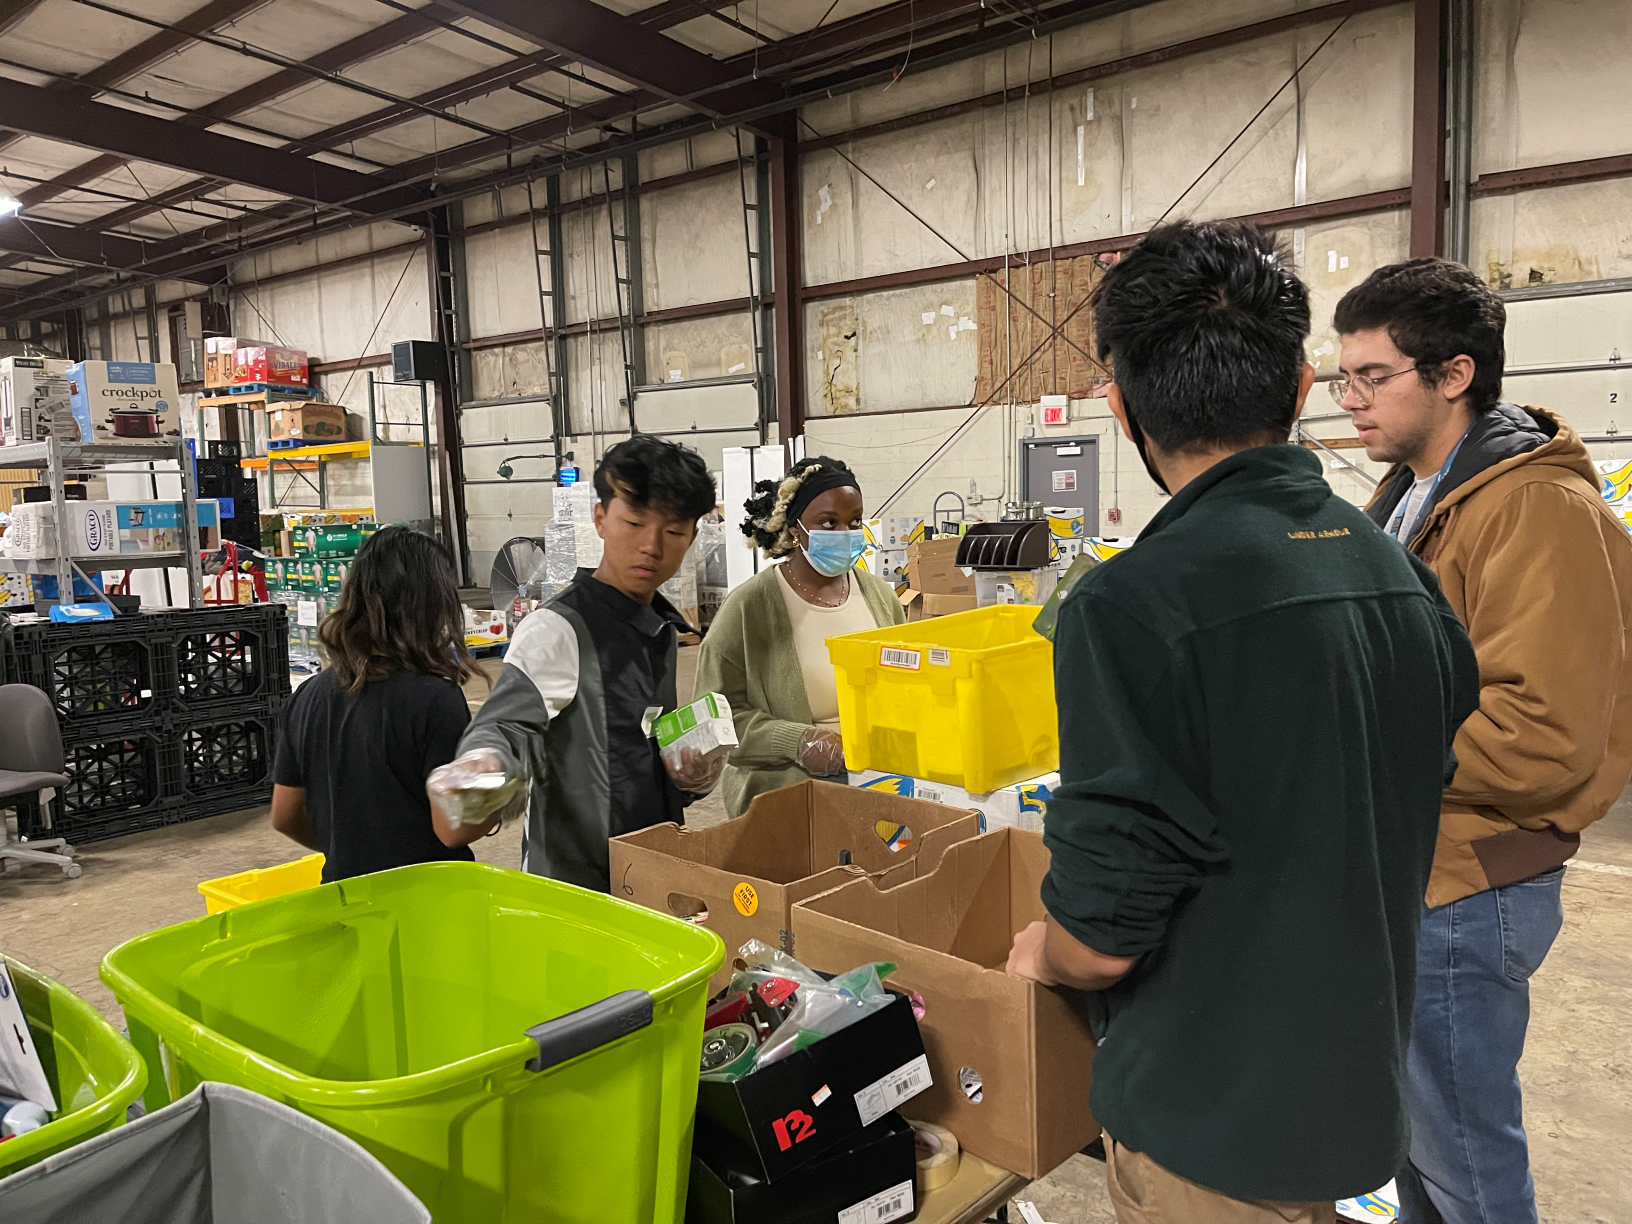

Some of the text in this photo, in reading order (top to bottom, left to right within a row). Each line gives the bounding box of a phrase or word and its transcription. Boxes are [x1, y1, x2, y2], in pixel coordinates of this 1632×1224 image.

[102, 386, 162, 401] crockpot
[1610, 393, 1618, 403] 2
[88, 514, 97, 546] GRACO
[740, 890, 752, 906] FIRST
[746, 886, 754, 898] USE
